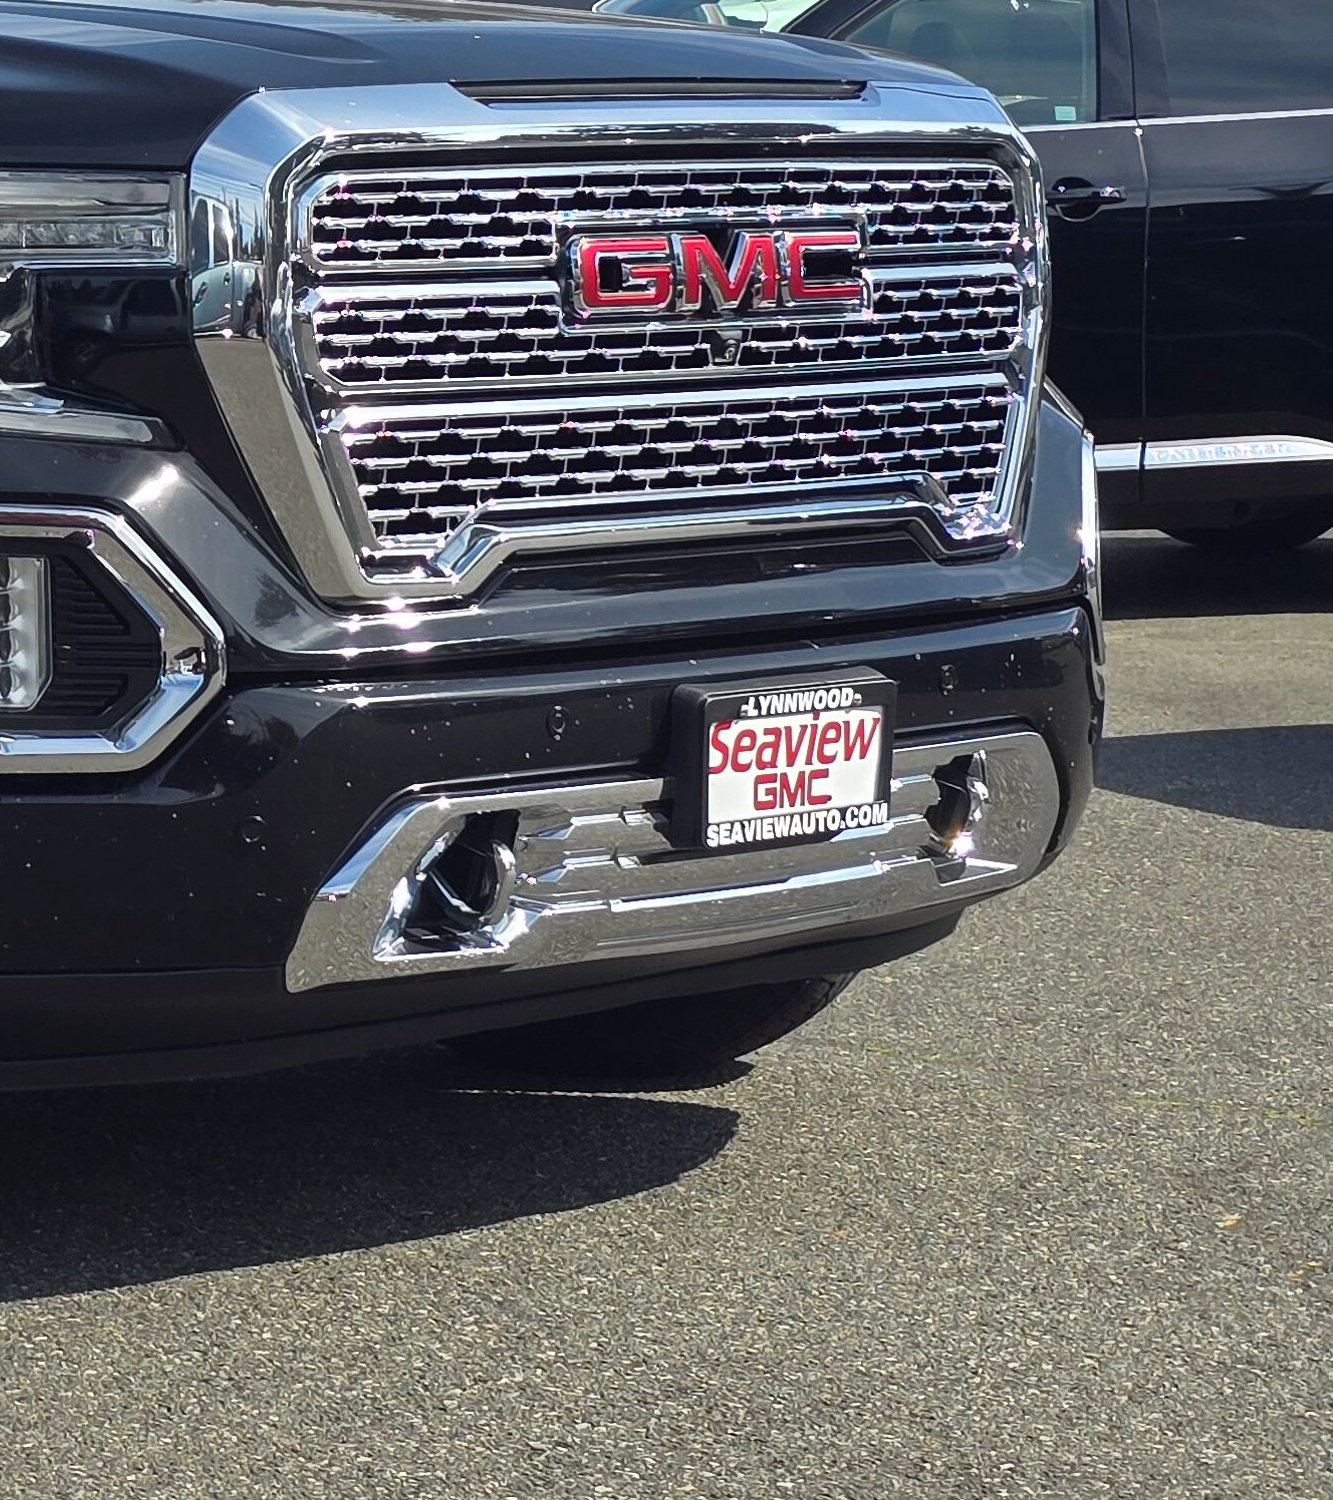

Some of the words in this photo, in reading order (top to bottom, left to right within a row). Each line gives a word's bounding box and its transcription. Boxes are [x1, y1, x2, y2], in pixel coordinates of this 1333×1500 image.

[566, 229, 866, 316] GMC
[744, 687, 855, 717] LYNNWOOD
[708, 711, 881, 775] Seaview
[753, 768, 833, 811] GMC
[706, 803, 888, 848] SEAVIEWAUTO.COM
